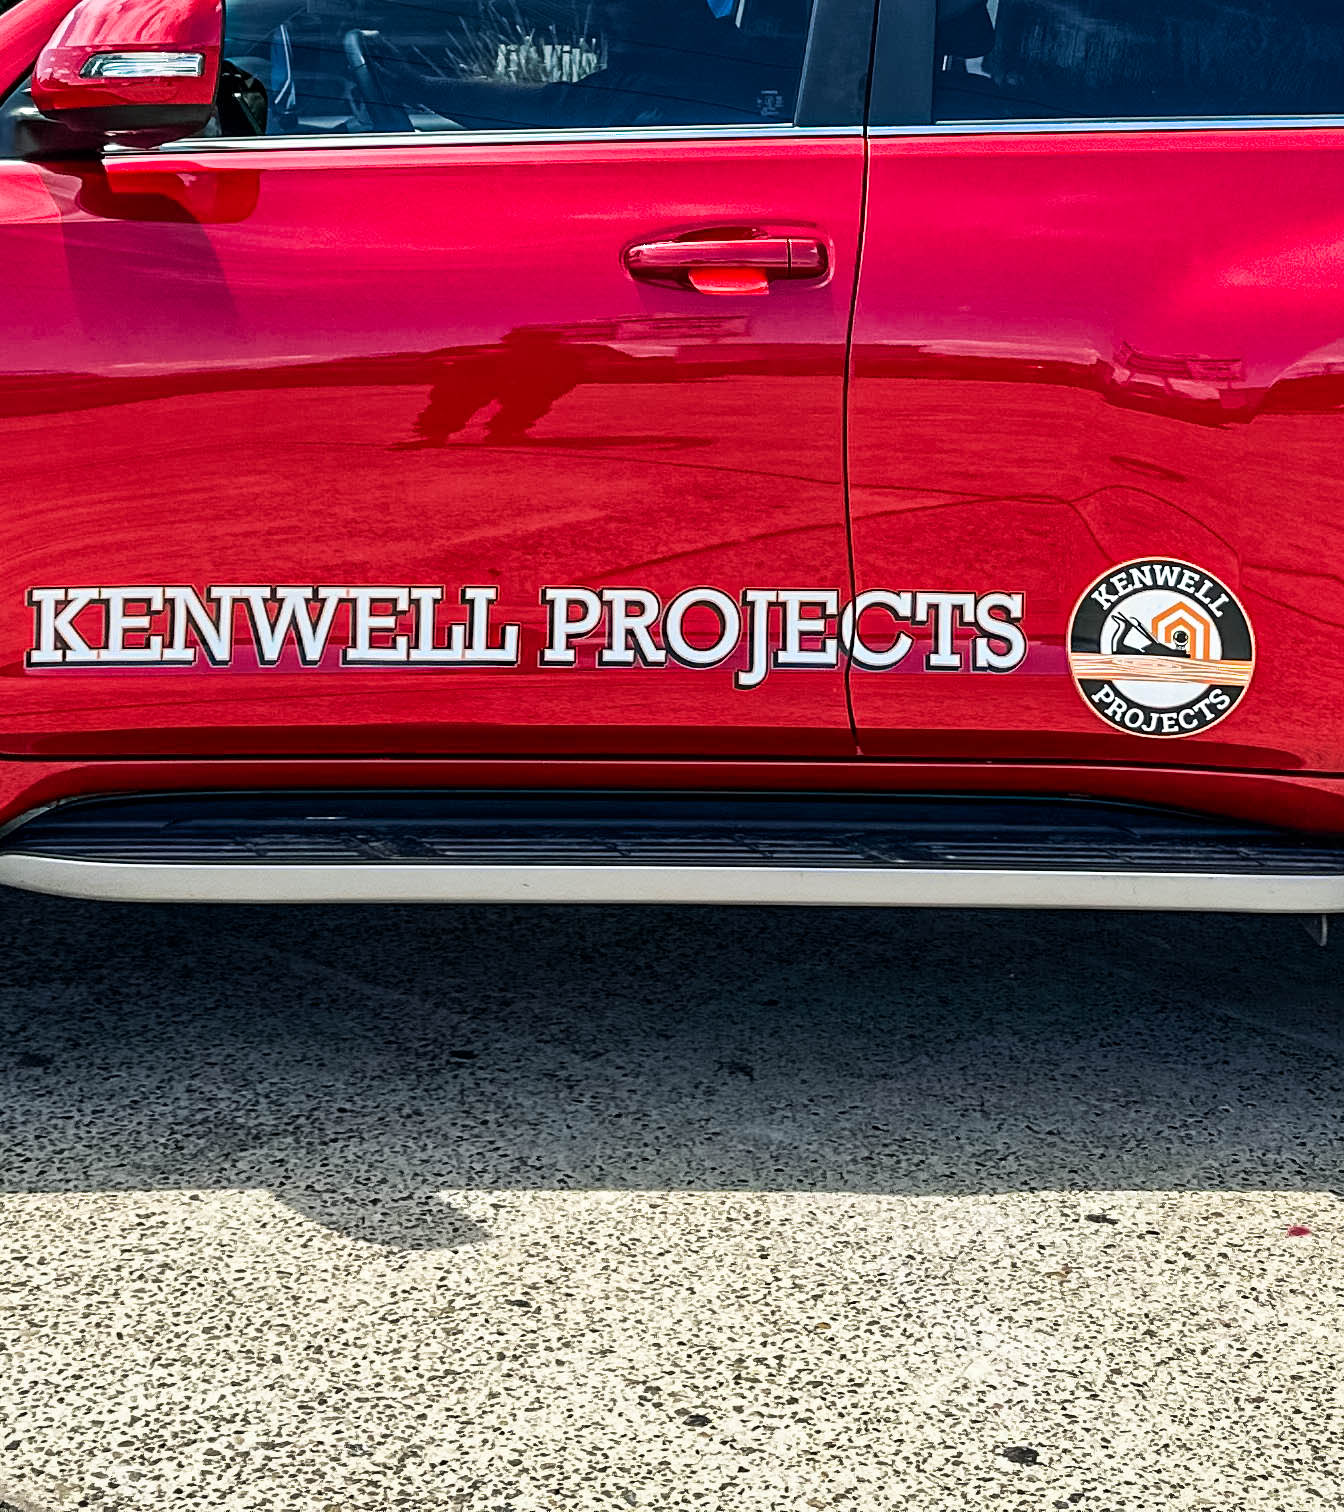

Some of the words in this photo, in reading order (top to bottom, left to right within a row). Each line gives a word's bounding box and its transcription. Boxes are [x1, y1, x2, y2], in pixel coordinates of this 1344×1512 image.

[1090, 564, 1230, 617] KENWELL
[25, 585, 521, 668] KENWELL
[539, 585, 1029, 690] PROJECTS
[1091, 684, 1231, 733] PROJECTS
